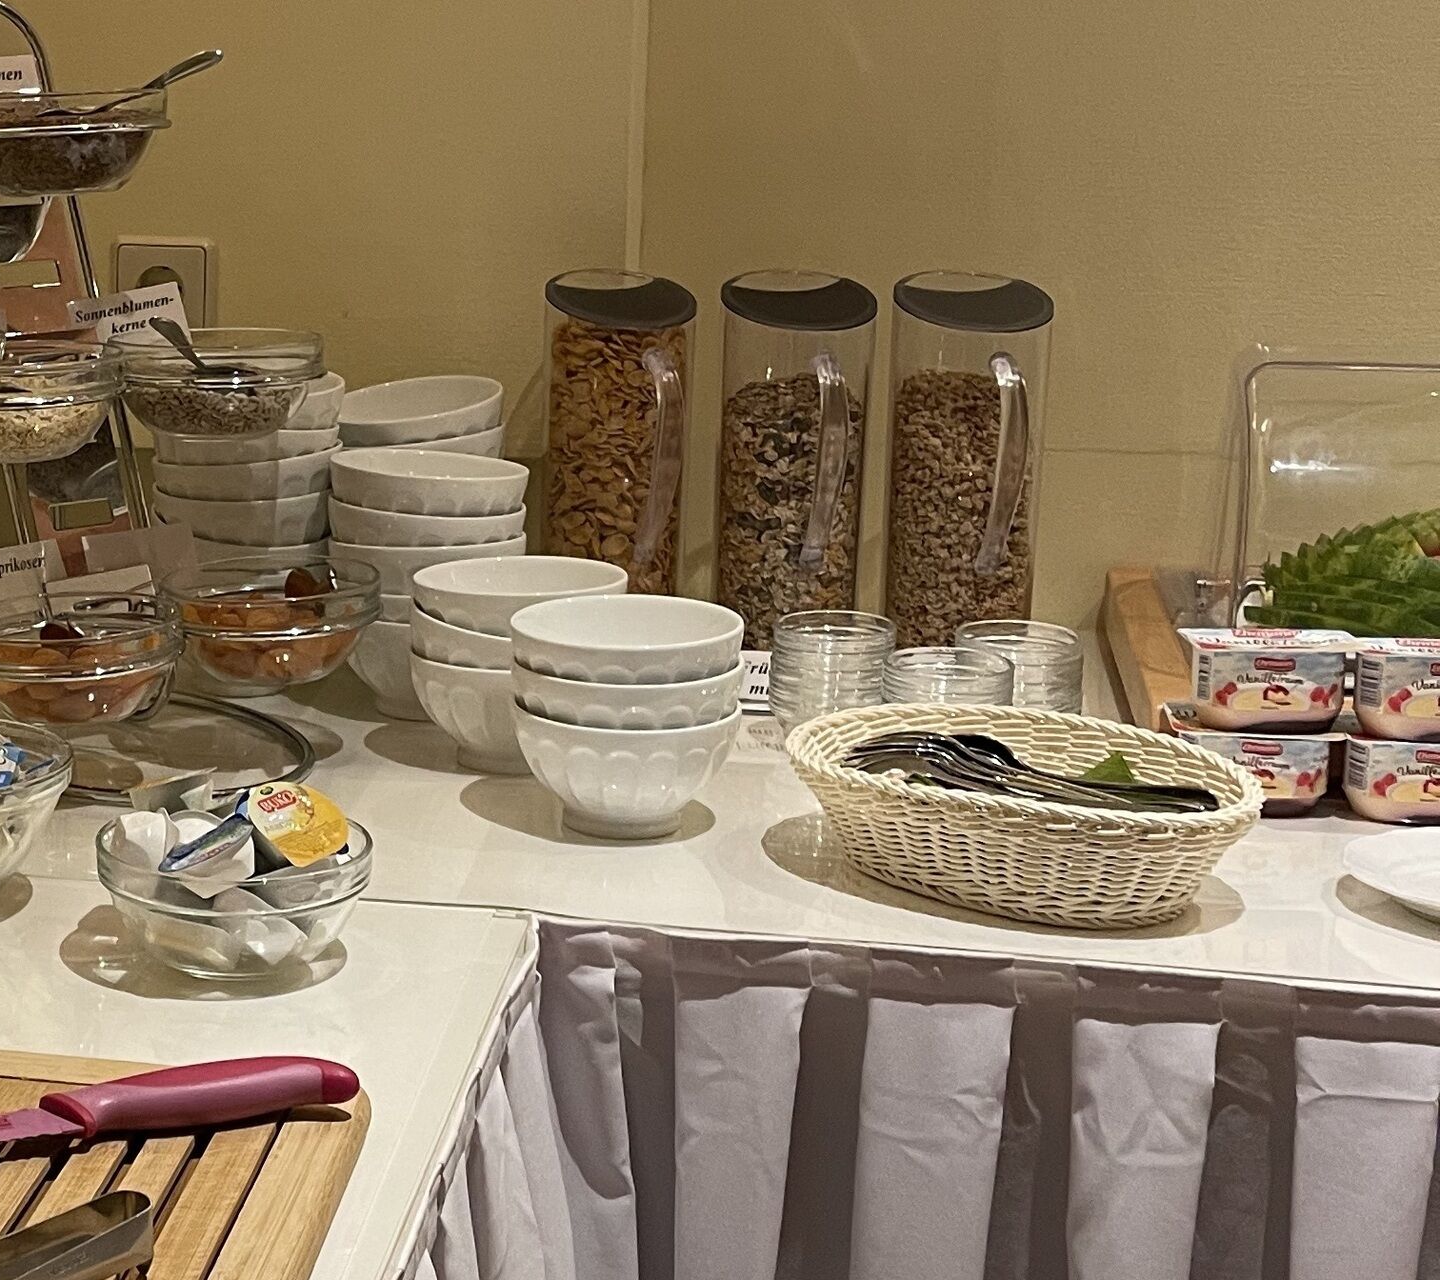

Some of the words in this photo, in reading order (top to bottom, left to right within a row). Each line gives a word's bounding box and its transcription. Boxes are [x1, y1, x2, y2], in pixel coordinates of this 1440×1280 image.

[75, 296, 174, 323] Sonnenblumen-
[111, 319, 147, 334] kerne
[259, 791, 296, 812] BUKO
